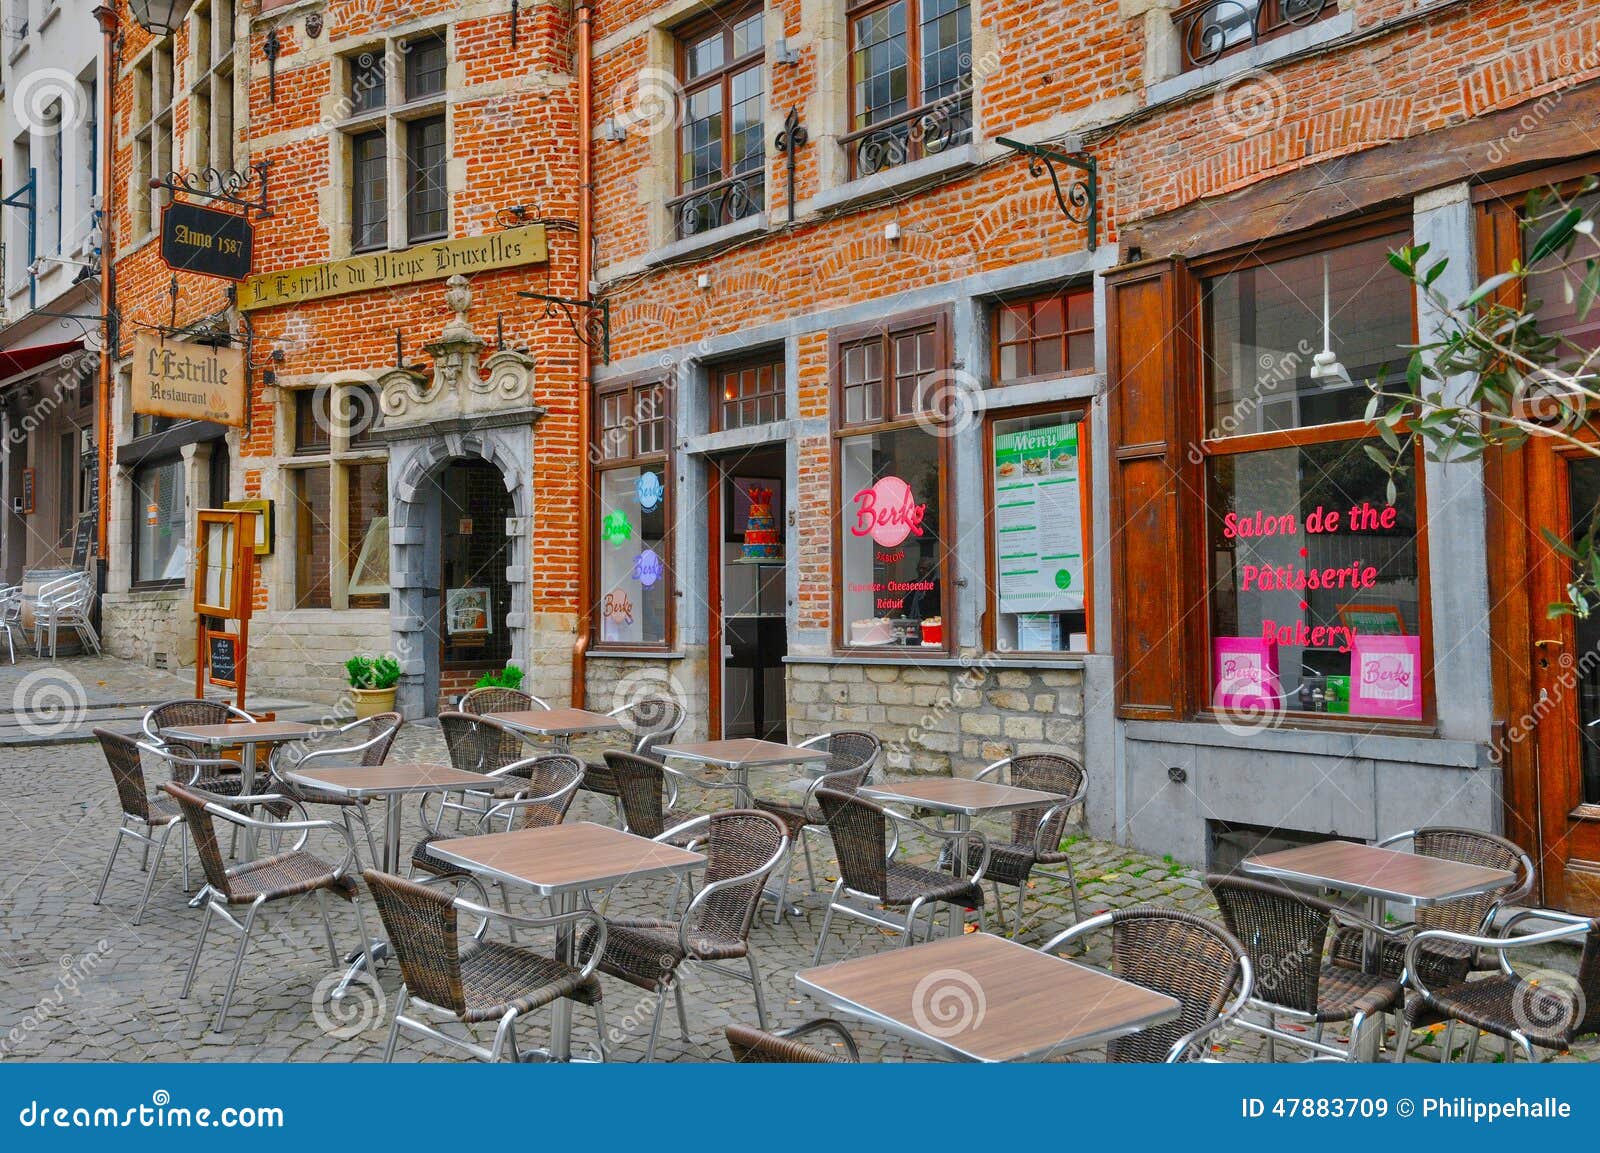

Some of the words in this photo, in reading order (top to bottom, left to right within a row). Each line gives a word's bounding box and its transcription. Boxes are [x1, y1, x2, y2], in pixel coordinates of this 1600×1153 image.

[174, 224, 212, 248] Anno
[218, 237, 243, 258] 1587
[346, 264, 366, 283] du
[432, 236, 521, 272] Bruxelles
[148, 348, 228, 385] L'Estrille
[151, 381, 207, 405] Restaurant
[1014, 434, 1057, 451] Menu
[851, 484, 926, 537] Berko
[1223, 511, 1297, 538] Salon
[1306, 506, 1340, 533] de
[511, 519, 519, 534] 7
[887, 580, 935, 592] Cheesecake
[1241, 561, 1377, 592] Pâtisserie
[603, 591, 633, 618] Berko
[1262, 619, 1358, 653] Bakery
[1363, 660, 1410, 688] Berko
